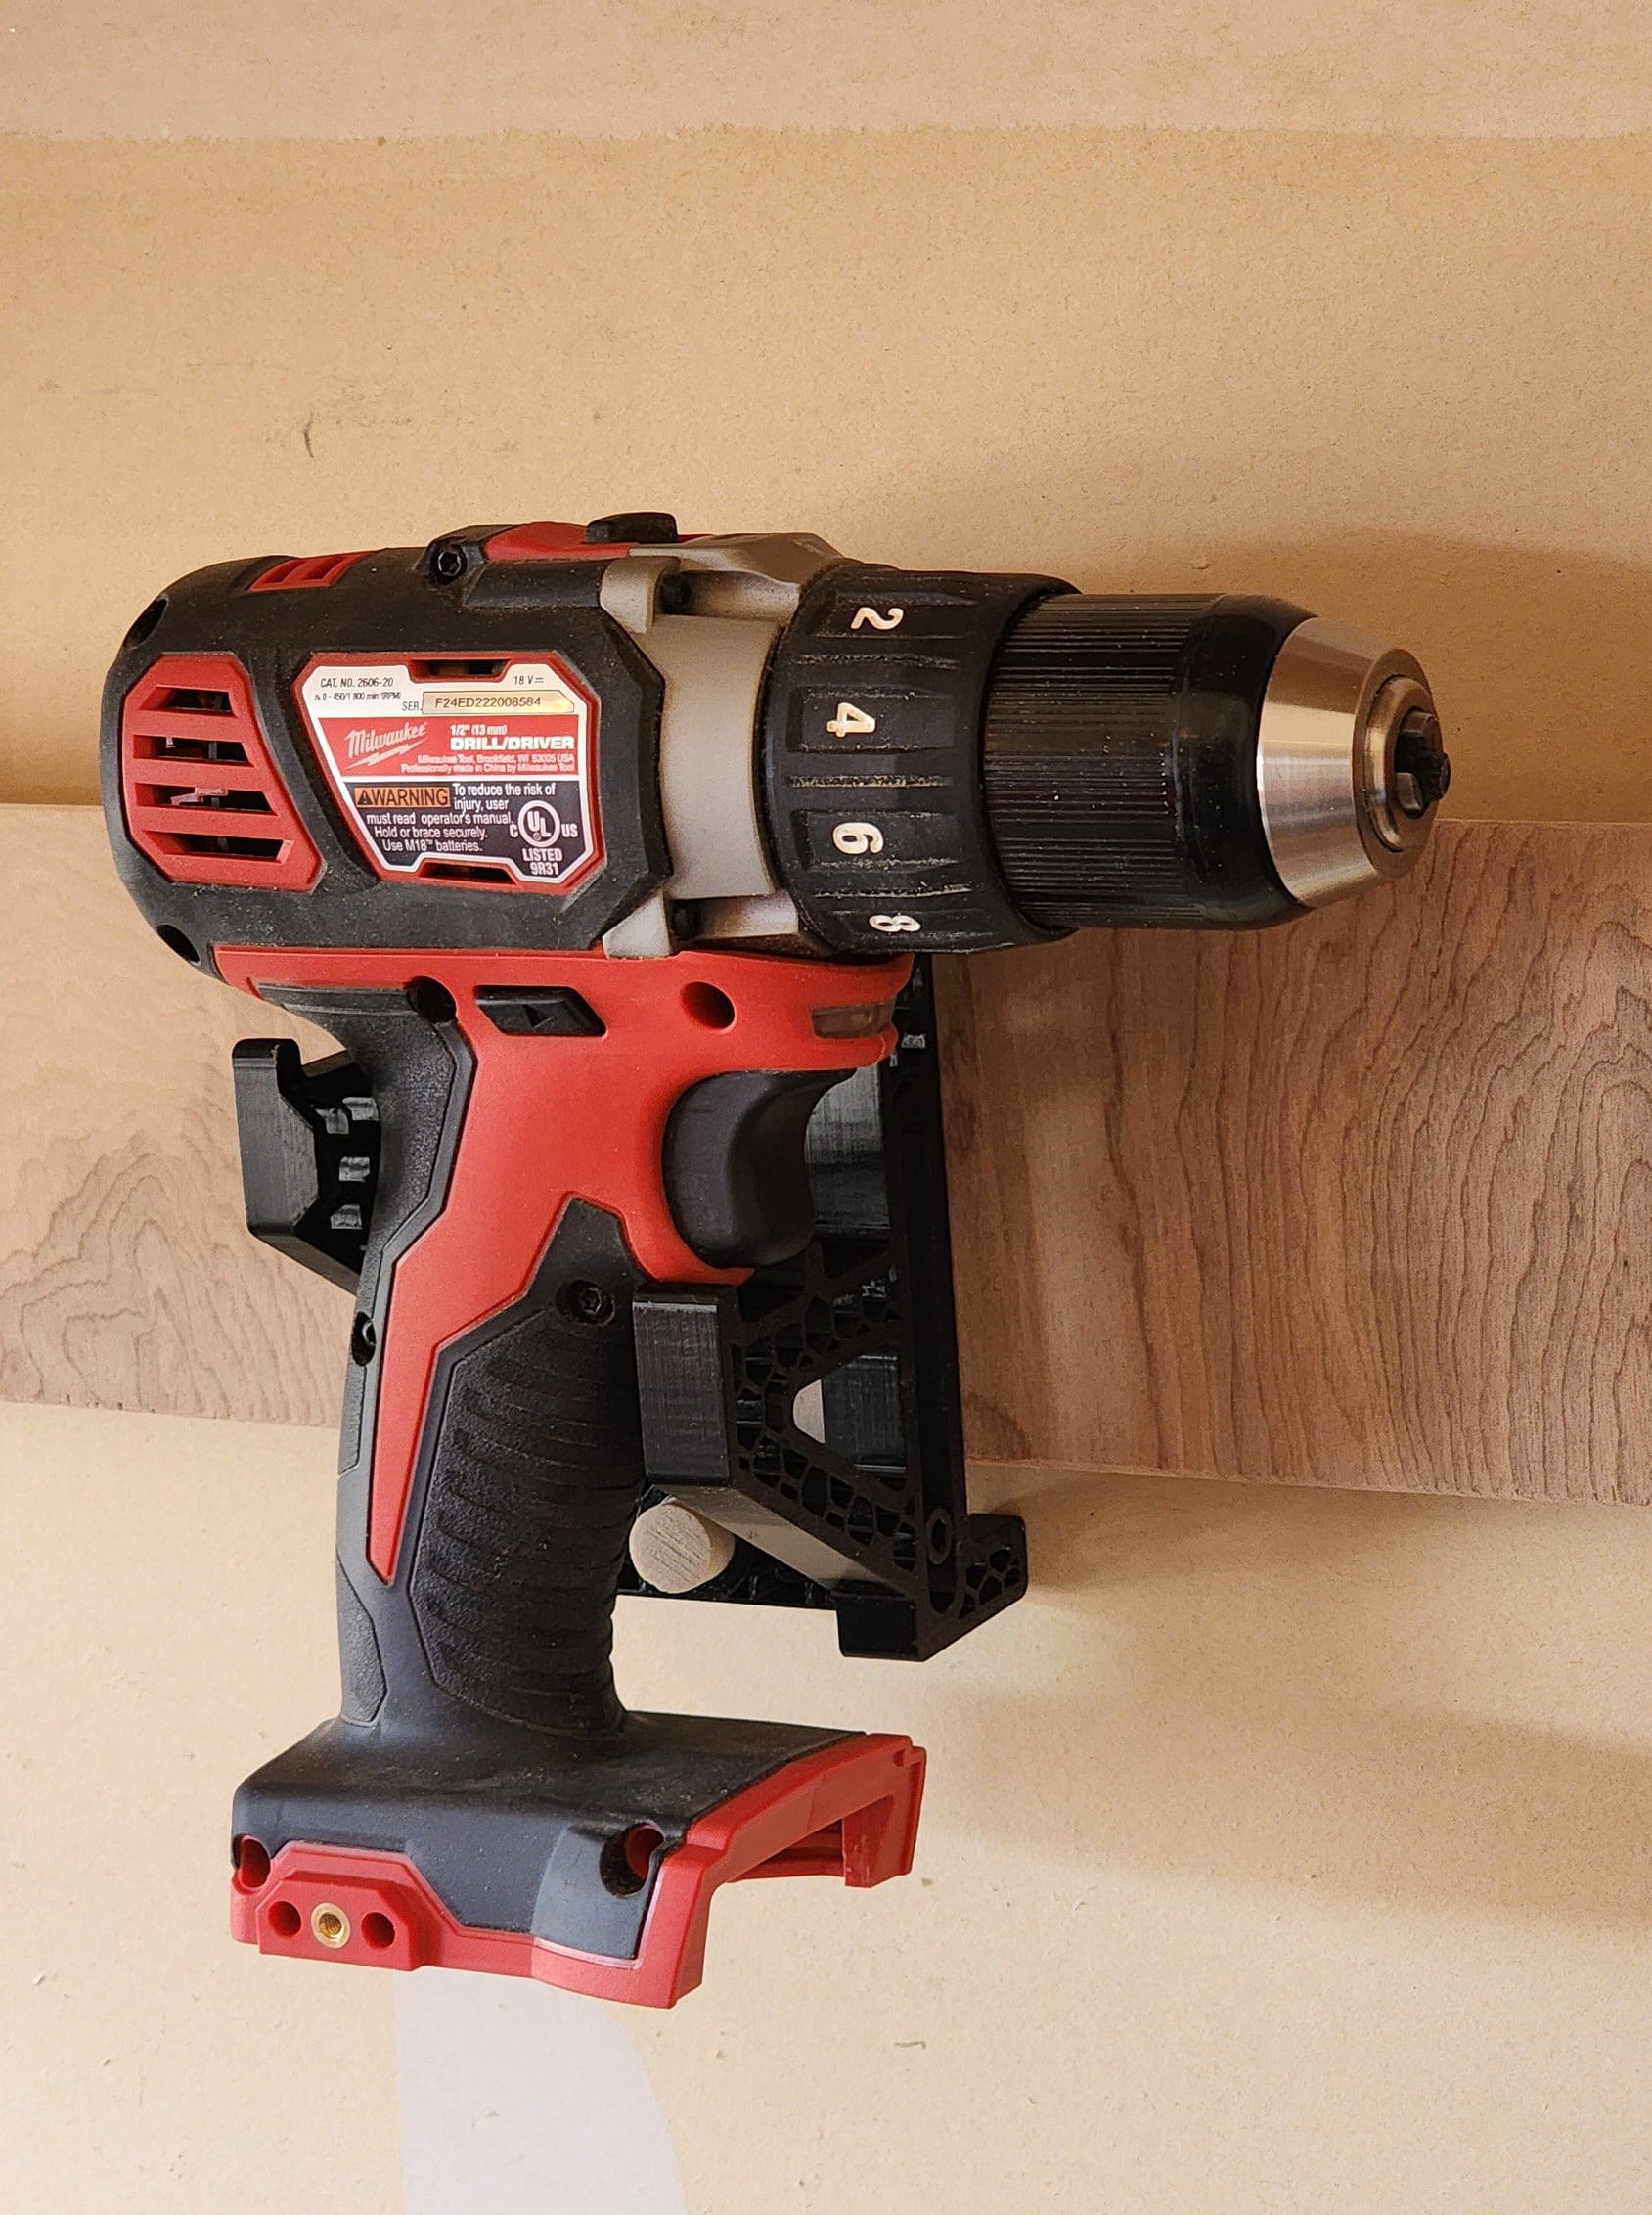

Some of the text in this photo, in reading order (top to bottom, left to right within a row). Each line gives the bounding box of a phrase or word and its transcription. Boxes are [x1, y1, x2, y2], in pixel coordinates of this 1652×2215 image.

[850, 607, 905, 631] 2
[320, 677, 394, 688] CAT. NO. 2606-20
[513, 675, 524, 686] 18
[401, 696, 541, 712] SER. F24ED222008584
[826, 702, 875, 738] 4
[344, 722, 426, 759] Milwaukee
[450, 736, 575, 751] DRILL/DRIVER
[557, 753, 575, 763] USA
[452, 783, 557, 796] To reduce the risk of
[371, 789, 448, 806] WARNING
[454, 797, 510, 815] injury, user
[366, 811, 514, 827] must read operator's manual.
[374, 826, 489, 841] Hold or brace securely.
[561, 823, 579, 838] US
[382, 839, 404, 852] Use
[434, 839, 483, 852] batteries.
[832, 822, 884, 855] 6
[522, 848, 564, 862] LISTED
[869, 914, 922, 933] 8
